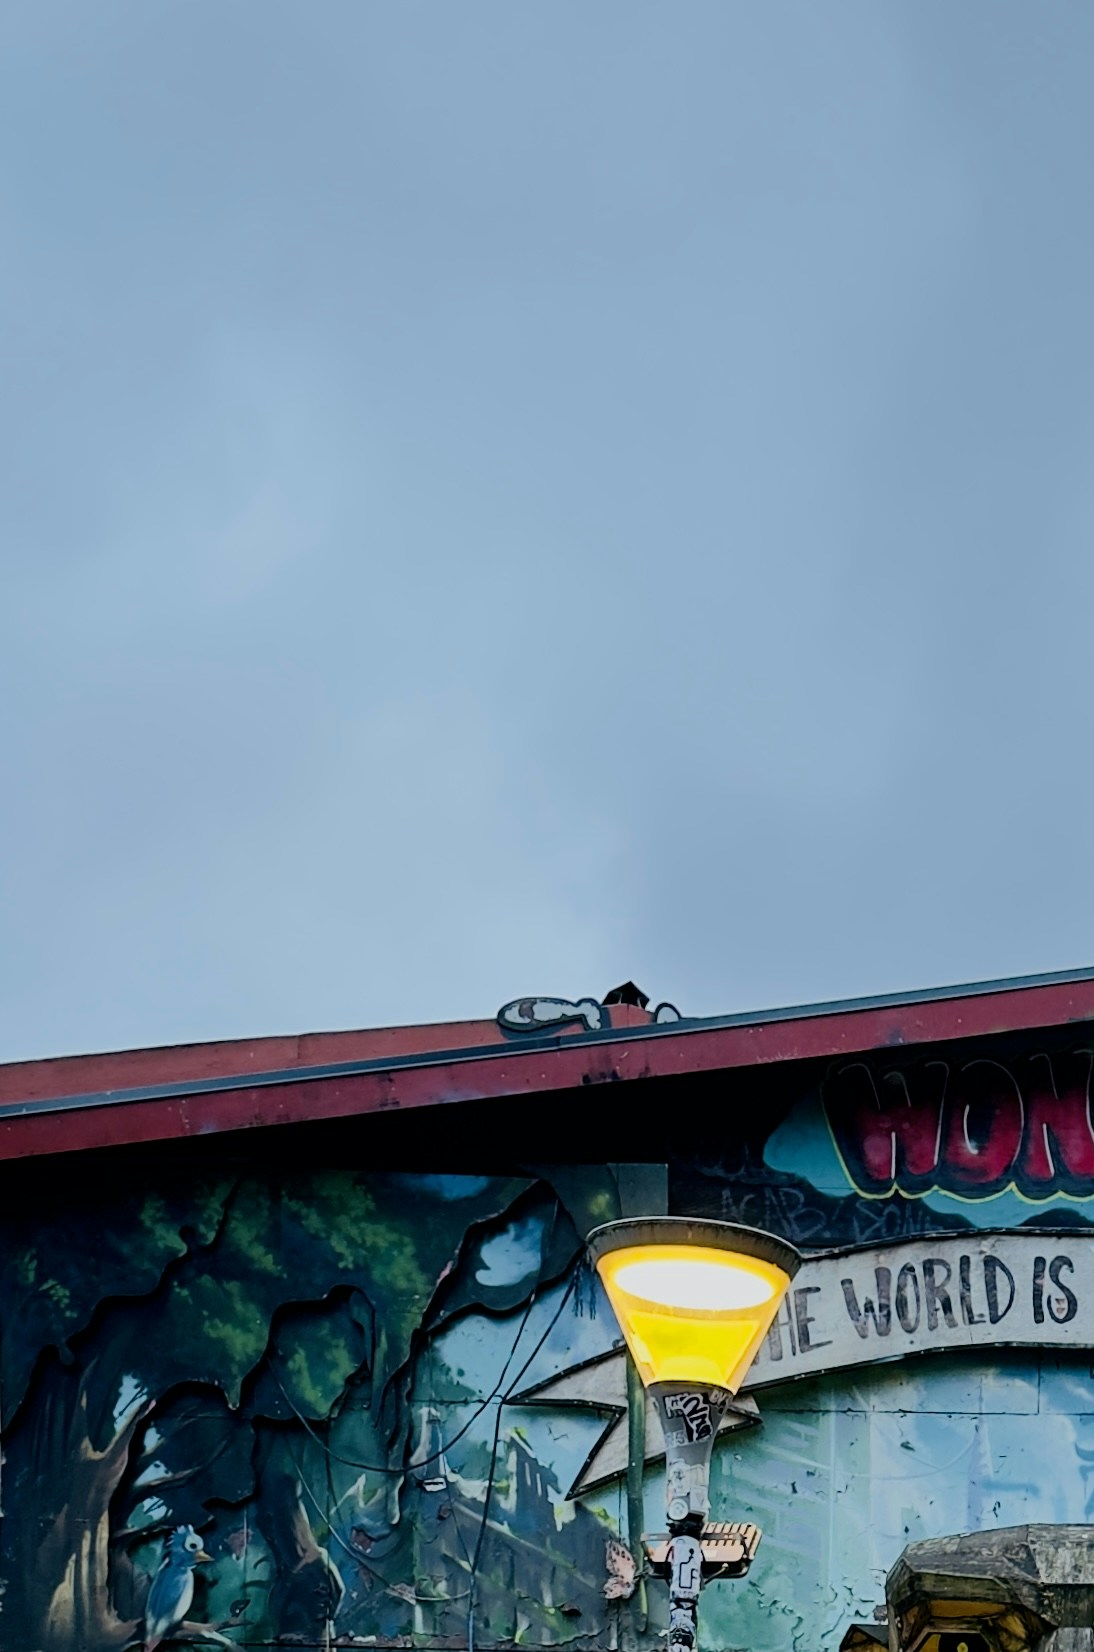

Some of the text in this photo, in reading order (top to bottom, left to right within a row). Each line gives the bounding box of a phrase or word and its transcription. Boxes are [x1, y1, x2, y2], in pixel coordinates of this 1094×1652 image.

[750, 1285, 834, 1366] HE
[840, 1254, 1016, 1340] WORLD
[1032, 1255, 1078, 1325] IS
